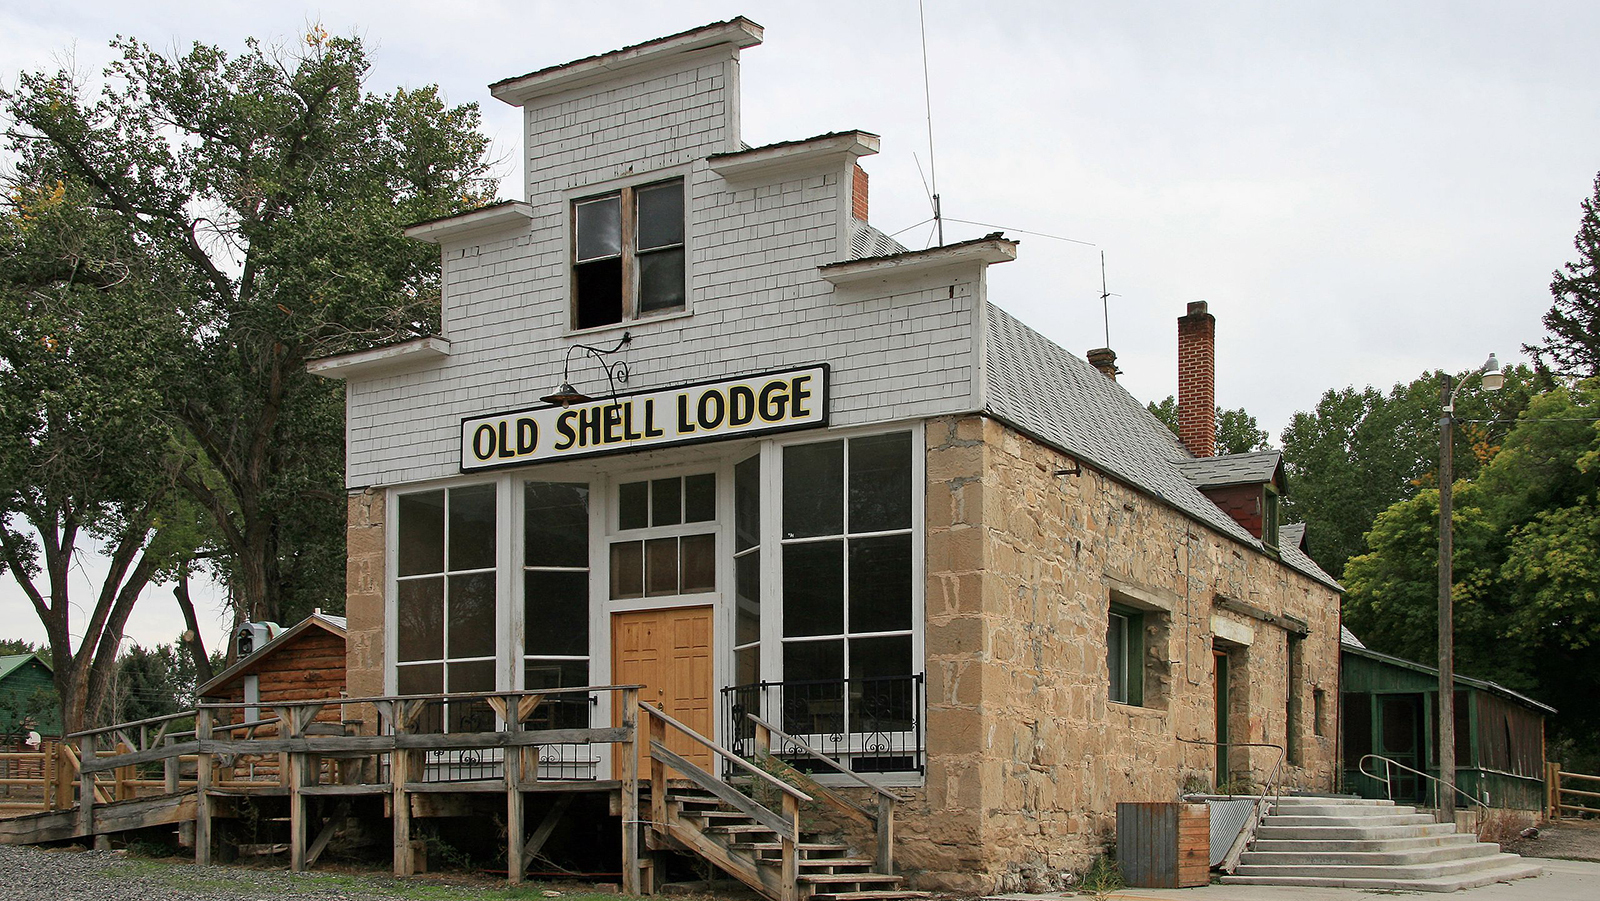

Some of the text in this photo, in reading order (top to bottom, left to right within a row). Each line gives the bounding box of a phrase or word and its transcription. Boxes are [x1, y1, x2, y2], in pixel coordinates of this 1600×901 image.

[473, 375, 812, 461] OLD SHELL LODGE
